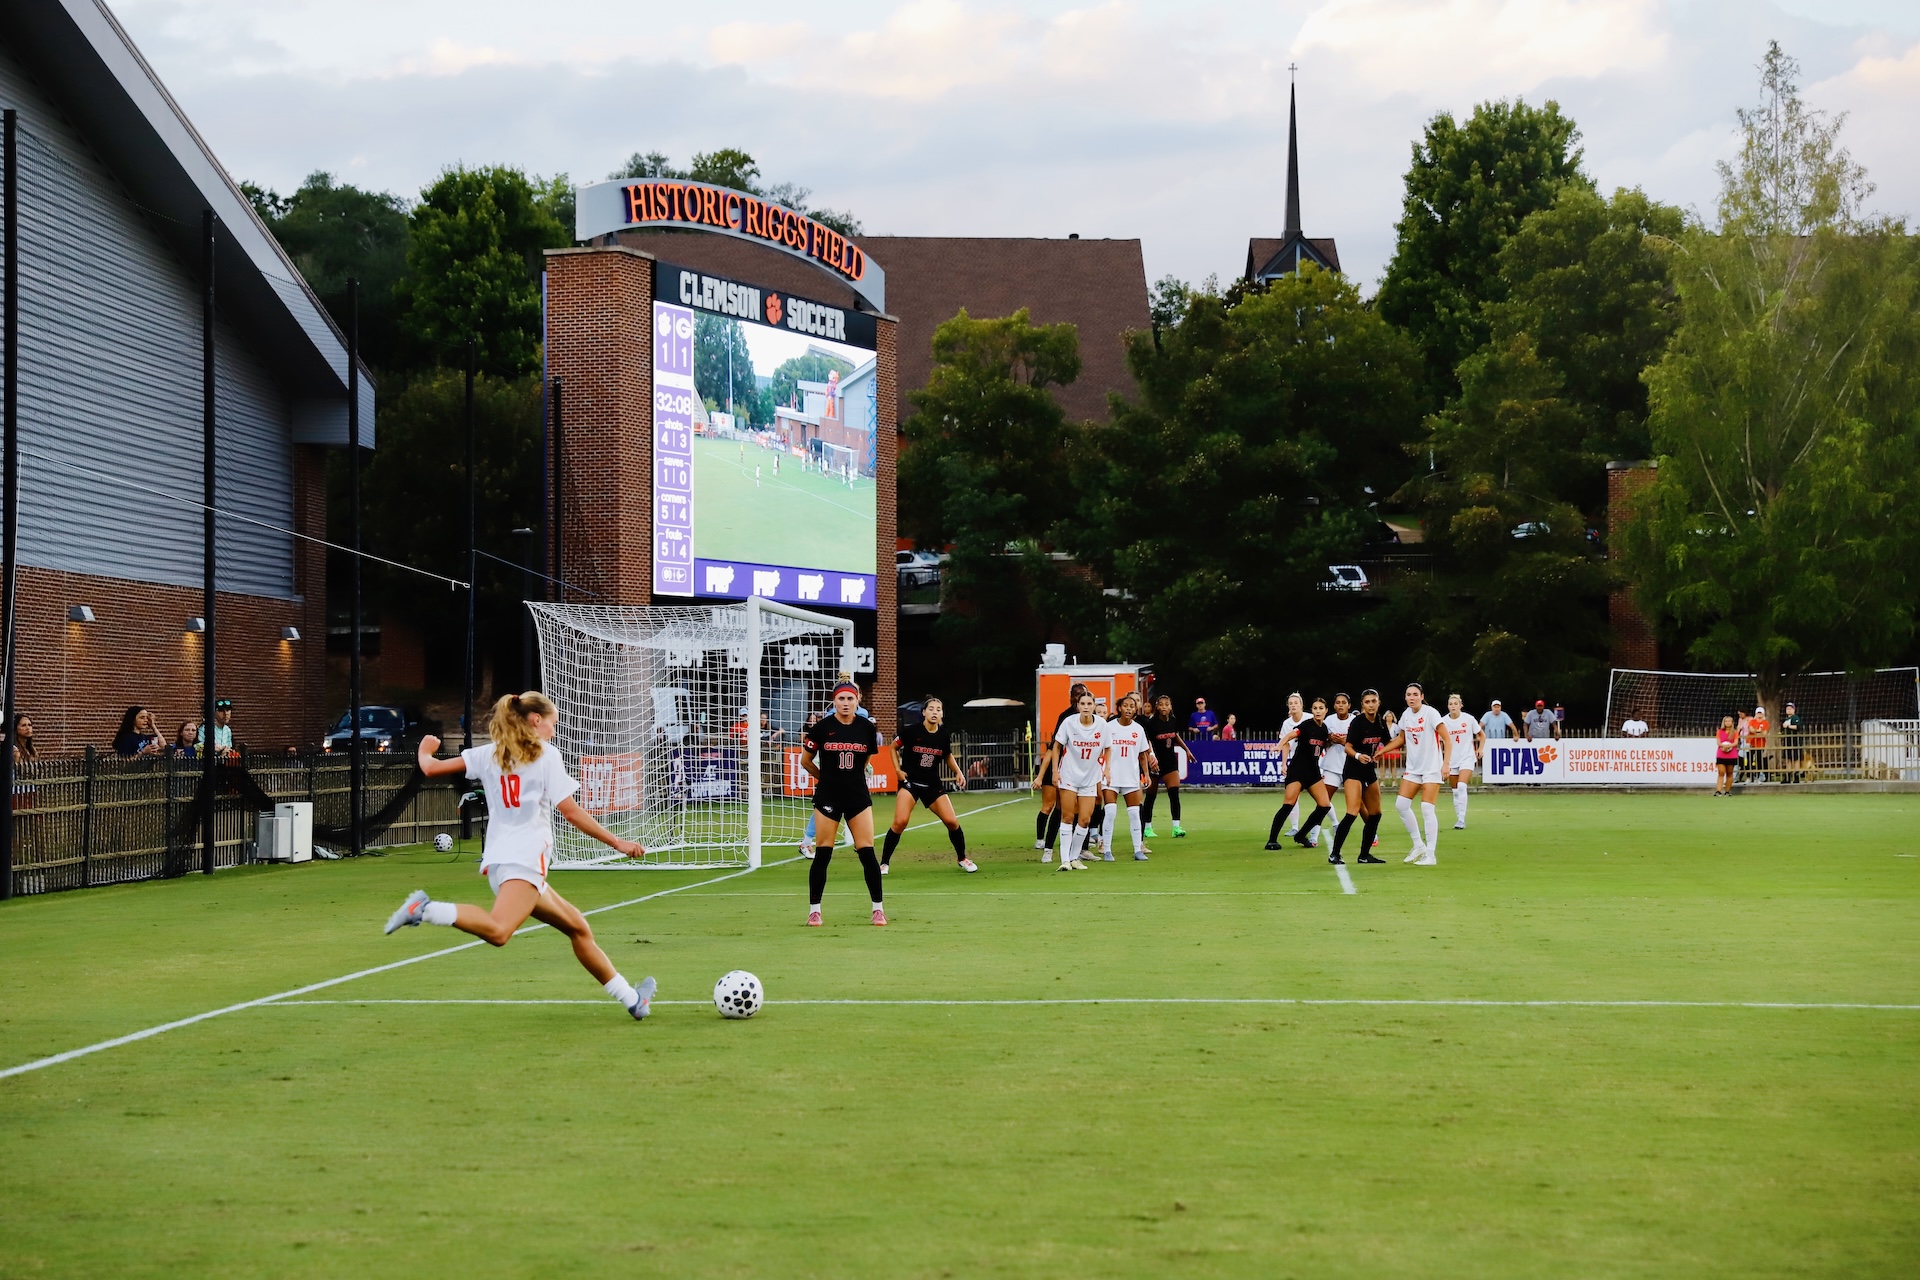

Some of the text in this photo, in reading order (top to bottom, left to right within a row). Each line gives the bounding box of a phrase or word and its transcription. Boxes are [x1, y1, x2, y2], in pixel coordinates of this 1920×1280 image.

[623, 183, 866, 281] HISTORIC RIGGS FIELD
[680, 270, 846, 341] CLEMSON SOCCER
[662, 342, 687, 368] 1 1
[656, 392, 691, 416] 32:08
[661, 431, 687, 448] 4 3
[663, 468, 687, 485] 1 0
[661, 505, 687, 521] 5 4
[661, 542, 687, 558] 5 4
[784, 644, 819, 671] 2021
[1112, 739, 1137, 747] CLEMSON
[1412, 733, 1418, 745] 5
[1455, 735, 1460, 743] 4
[824, 742, 868, 752] GEORGIA
[912, 746, 942, 756] GEORGIA
[1081, 748, 1092, 760] 17
[1121, 746, 1128, 757] 11
[1569, 749, 1673, 760] SUPPORTING CLEMSON
[839, 752, 854, 769] 10
[920, 754, 935, 768] 22
[1244, 751, 1267, 759] RING
[1491, 748, 1544, 775] IPTAY
[1202, 762, 1261, 775] DELIAH
[1569, 761, 1658, 772] STUDENT-ATHLETES
[1660, 761, 1688, 772] SINCE
[500, 774, 521, 808] 10
